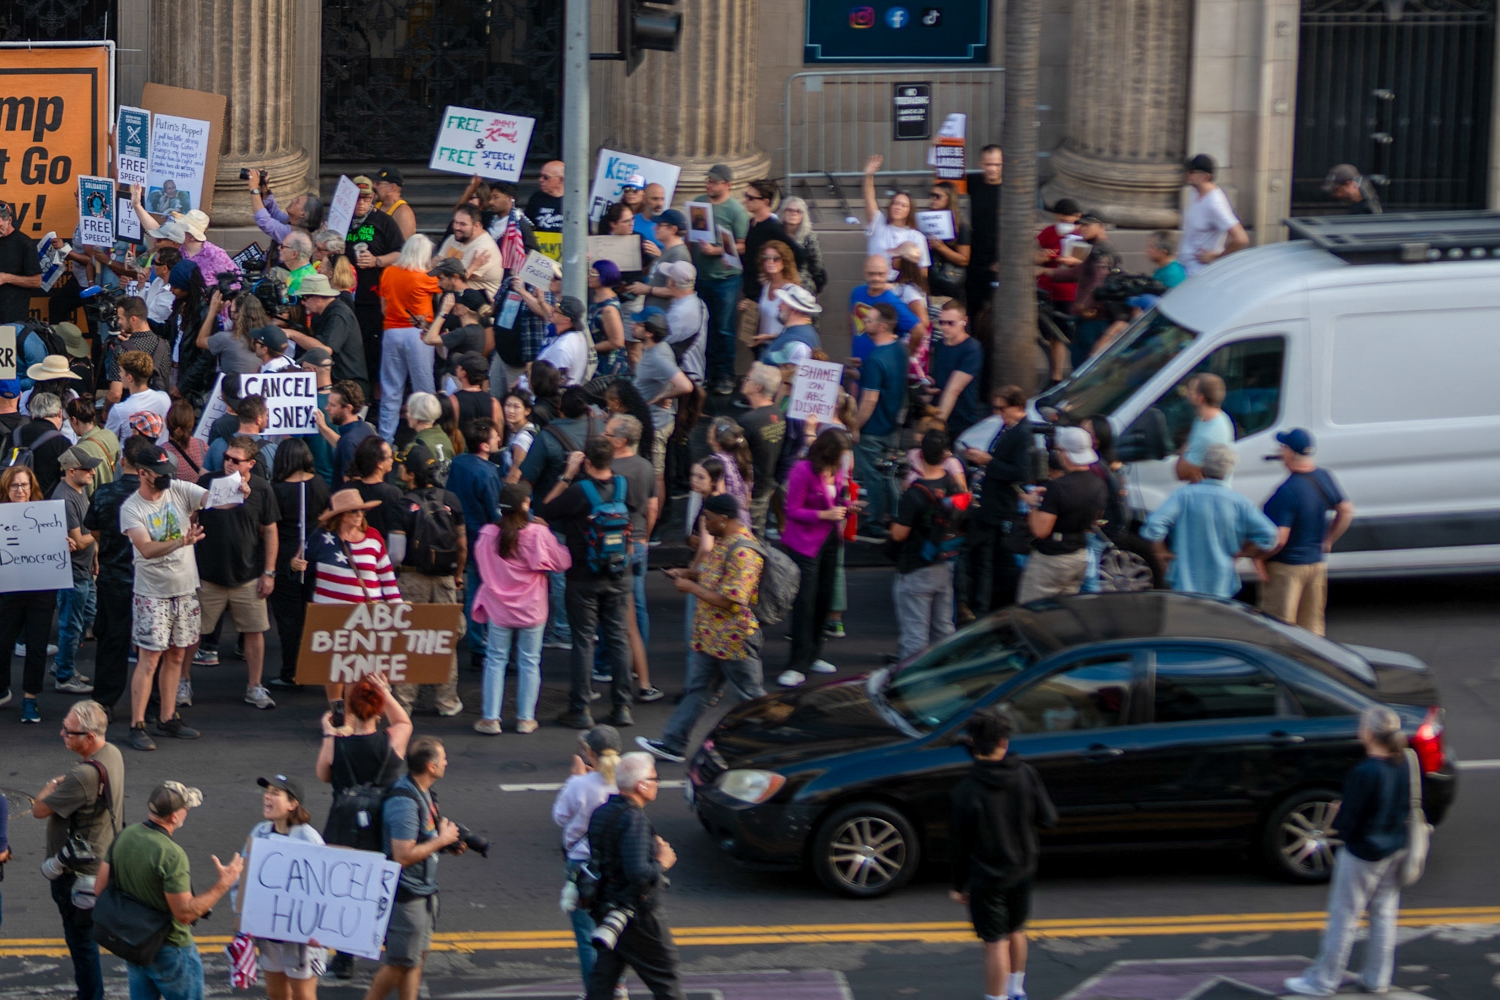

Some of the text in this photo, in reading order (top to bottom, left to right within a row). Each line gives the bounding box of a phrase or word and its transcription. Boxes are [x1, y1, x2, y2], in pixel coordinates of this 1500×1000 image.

[155, 117, 180, 132] Putin's
[181, 123, 203, 138] Puppet
[446, 115, 518, 133] FREE JIMMY
[475, 138, 485, 149] &
[120, 157, 146, 173] FREE
[438, 146, 516, 167] FREE SPEECH
[21, 146, 72, 186] Go
[484, 160, 516, 172] 4 ALL
[938, 167, 964, 178] TRUMP
[120, 171, 146, 184] SPEECH
[84, 182, 108, 191] SOLIDARITY
[121, 218, 139, 227] ACTUAL
[127, 210, 132, 218] T
[83, 219, 111, 234] FREE
[127, 226, 132, 234] F
[84, 233, 111, 244] SPEECH
[799, 365, 840, 382] SHAME
[244, 377, 315, 398] CANCEL
[808, 382, 825, 391] ON
[794, 400, 834, 417] DISNEY
[23, 506, 62, 533] Speech
[344, 603, 413, 630] ABC
[312, 629, 453, 654] BENT THE
[330, 653, 408, 683] KNEE
[258, 851, 373, 901] CANCEL
[271, 894, 362, 938] HULU
